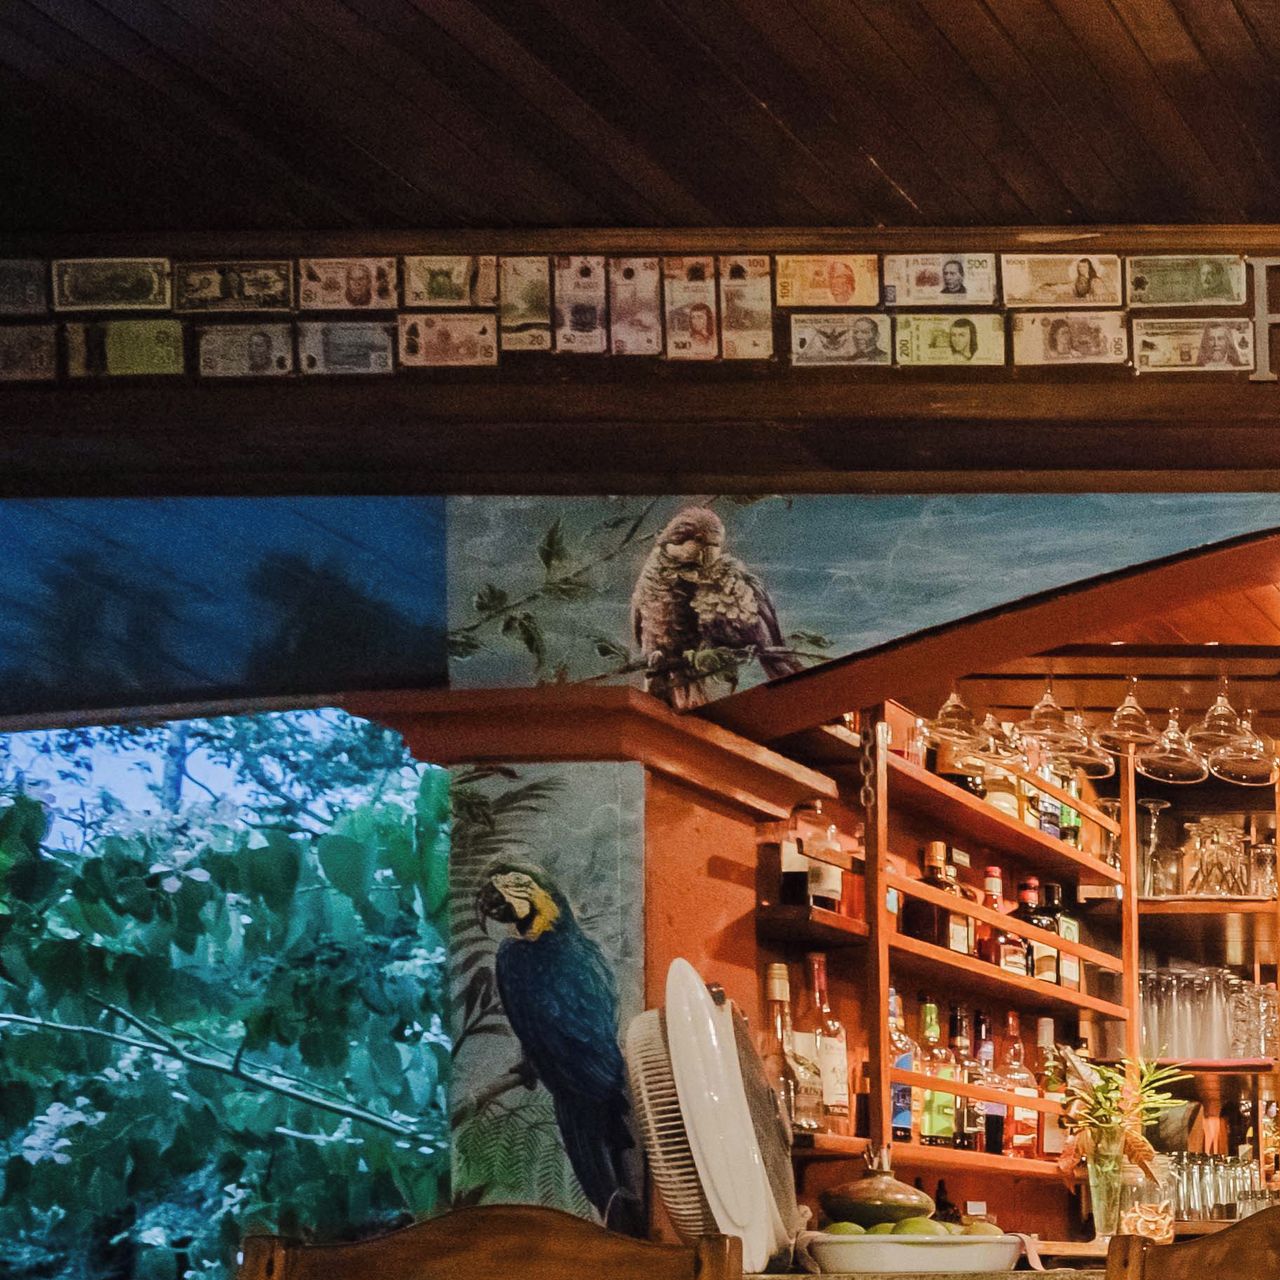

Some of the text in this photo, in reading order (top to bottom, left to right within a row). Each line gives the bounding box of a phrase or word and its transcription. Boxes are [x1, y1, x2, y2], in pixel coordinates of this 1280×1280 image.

[967, 259, 988, 269] 500
[528, 334, 545, 346] 20
[1112, 337, 1124, 356] 500
[899, 339, 909, 357] 200
